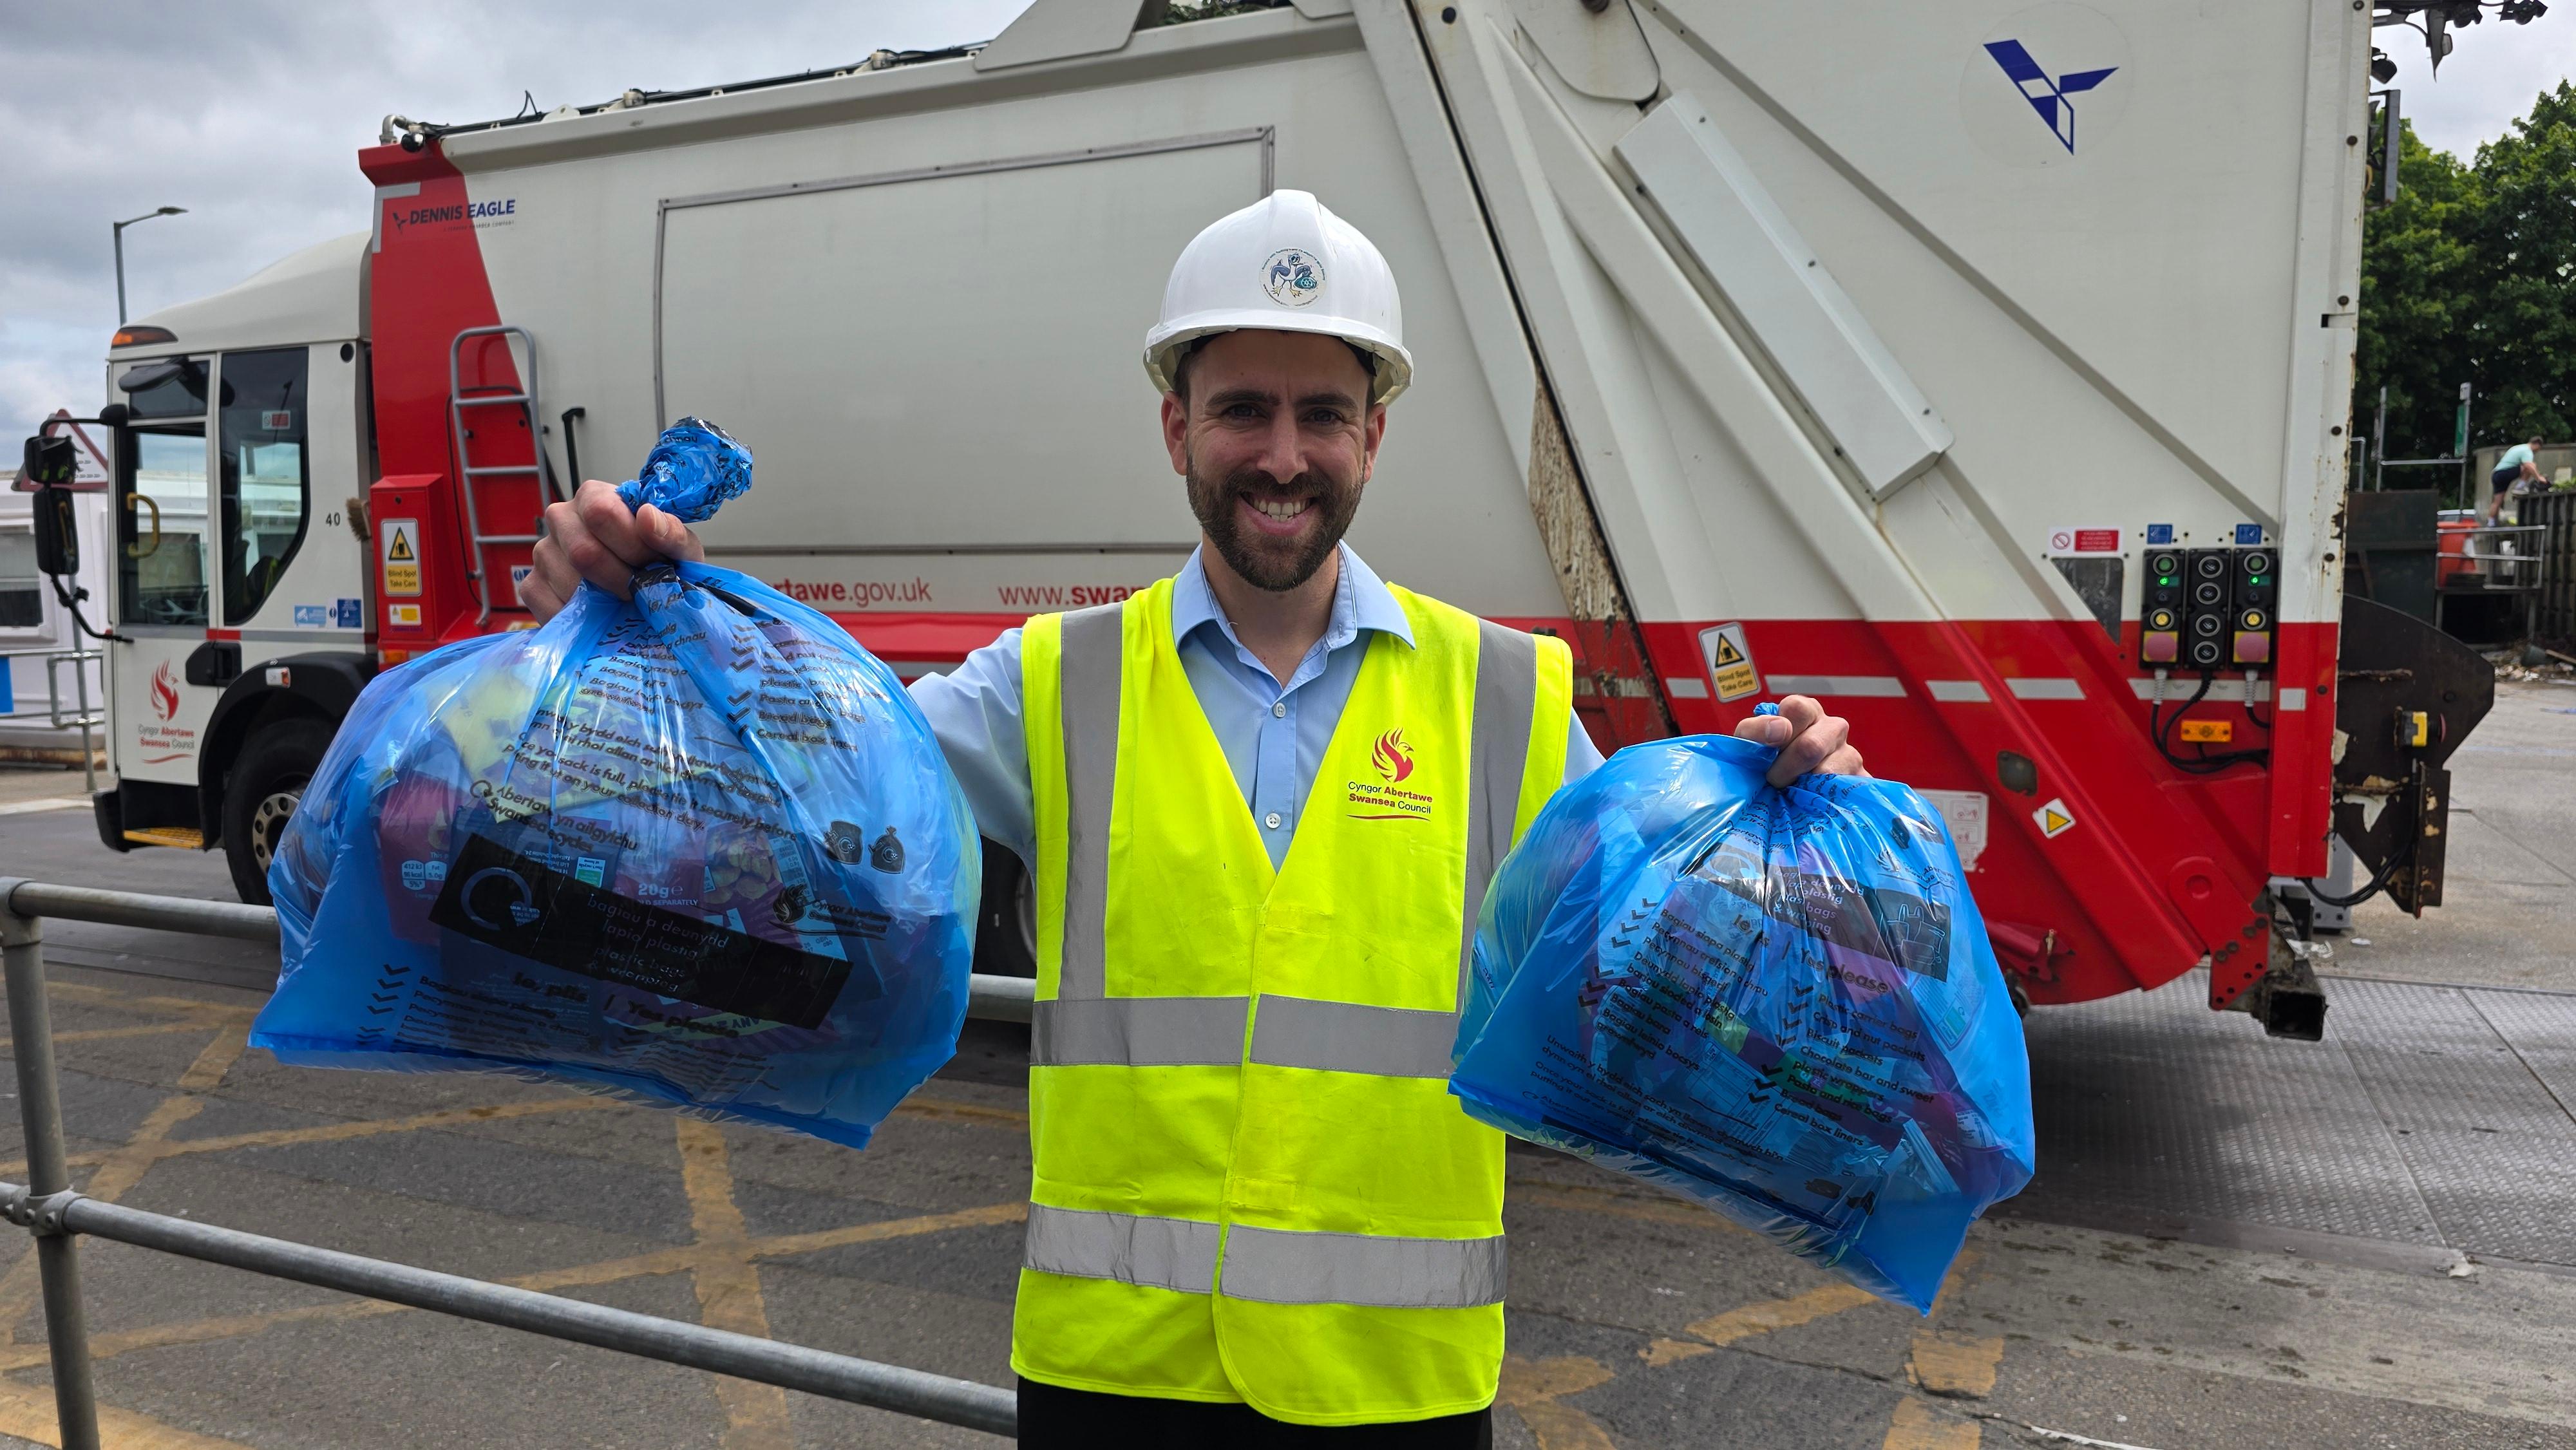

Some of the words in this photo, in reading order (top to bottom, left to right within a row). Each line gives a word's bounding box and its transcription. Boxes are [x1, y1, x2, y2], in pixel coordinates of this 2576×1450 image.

[410, 205, 462, 225] DENNIS
[467, 199, 515, 219] EAGLE
[404, 568, 417, 578] Spot
[589, 677, 634, 693] Bagiau
[1717, 672, 1734, 683] Blind
[1736, 668, 1750, 679] Spot
[1721, 683, 1736, 692] Take
[1738, 679, 1753, 688] Care
[558, 757, 589, 773] sack
[589, 764, 601, 777] is
[606, 745, 638, 762] allan
[563, 775, 582, 786] on
[582, 781, 617, 798] your
[676, 811, 706, 832] day.
[1349, 781, 1381, 793] Cyngor
[1384, 786, 1433, 802] Abertawe
[1349, 793, 1395, 807] Swansea
[1398, 800, 1431, 814] Council
[486, 796, 547, 834] Swansea
[552, 813, 574, 828] yn
[587, 894, 641, 923] bagiau
[662, 920, 730, 949] deunydd
[1805, 903, 1836, 919] bags
[602, 919, 641, 943] lapio
[645, 936, 699, 961] plastig
[1652, 922, 1699, 955] Pecynnau
[1700, 952, 1737, 978] creision
[1660, 909, 1696, 933] Bagiau
[1696, 929, 1723, 950] siopa
[1724, 946, 1756, 972] plastig
[1627, 963, 1660, 988] bariau
[1634, 951, 1680, 983] Deunydd
[1680, 977, 1704, 999] lapio
[1643, 936, 1690, 970] Pecynnau
[1692, 965, 1730, 992] bisgedi
[1611, 993, 1645, 1021] Bagiau
[1646, 1015, 1671, 1035] bara
[1619, 979, 1653, 1005] Bagiau
[1653, 1002, 1683, 1022] pasta
[1603, 1008, 1638, 1034] Bagiau
[1638, 1029, 1666, 1050] leinio
[1665, 1045, 1701, 1071] bocsys
[1813, 1011, 1839, 1031] Crisp
[1840, 1025, 1861, 1038] and
[1862, 1031, 1882, 1046] nut
[1882, 1040, 1926, 1062] packets
[1852, 1010, 1888, 1027] carrier
[1889, 1021, 1918, 1041] bags
[1542, 1046, 1566, 1065] dynn
[1567, 1063, 1585, 1075] cyn
[1547, 1035, 1587, 1064] Unwaith
[1587, 1060, 1596, 1069] y
[1596, 1064, 1624, 1084] bydd
[1806, 1027, 1841, 1048] Biscuit
[1840, 1045, 1884, 1066] packets
[1530, 1070, 1565, 1092] putting
[1574, 1092, 1591, 1104] out
[1535, 1060, 1560, 1078] Once
[1560, 1075, 1584, 1090] your
[1585, 1088, 1609, 1104] sack
[1800, 1045, 1853, 1074] Chocolate
[1855, 1066, 1875, 1082] bar
[1876, 1077, 1900, 1092] and
[1900, 1086, 1935, 1104] sweet
[1829, 1074, 1885, 1102] wrappers
[1787, 1073, 1817, 1095] Pasta
[1818, 1091, 1842, 1104] and
[1842, 1097, 1863, 1111] rice
[1863, 1104, 1893, 1124] bags
[1774, 1103, 1810, 1124] Cereal
[1810, 1117, 1832, 1134] box
[1833, 1127, 1864, 1147] liners
